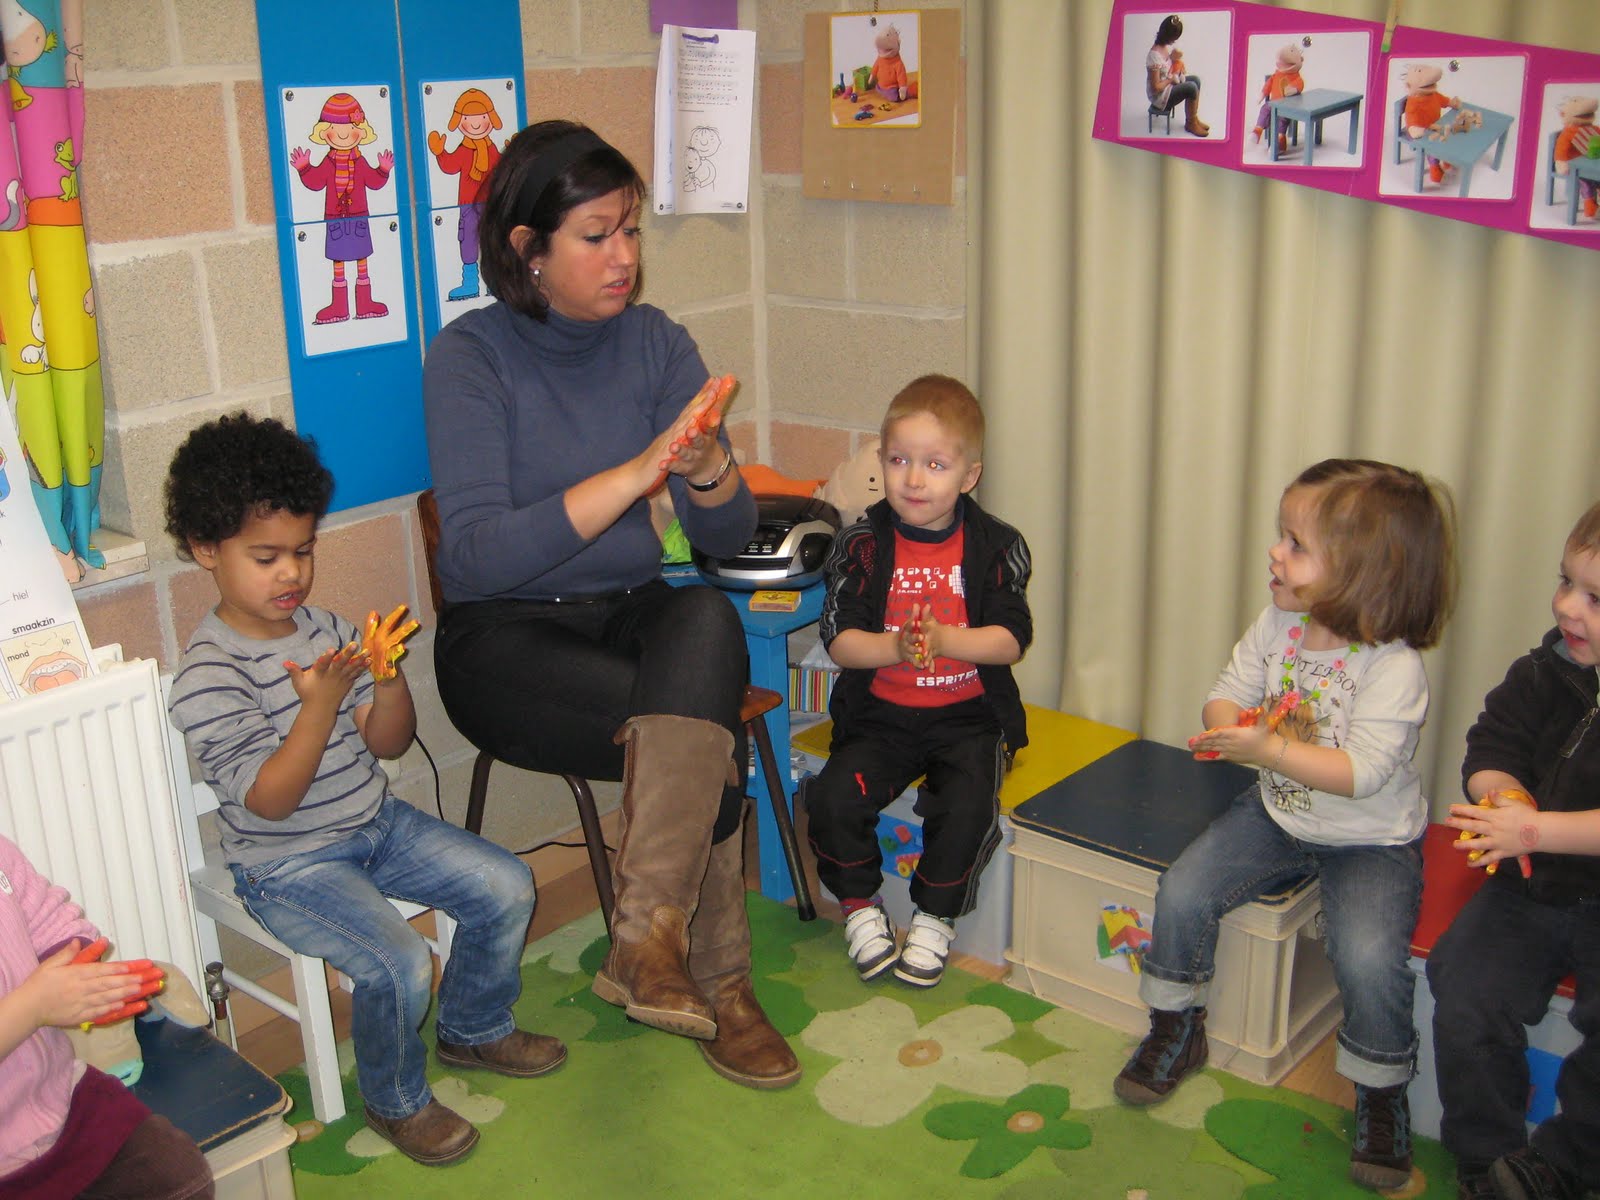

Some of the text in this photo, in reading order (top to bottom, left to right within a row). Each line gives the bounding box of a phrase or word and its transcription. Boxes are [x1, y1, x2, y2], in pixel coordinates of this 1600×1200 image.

[12, 590, 29, 602] hiel
[12, 616, 55, 635] smaakzin
[62, 638, 71, 646] lip
[7, 650, 30, 663] mond
